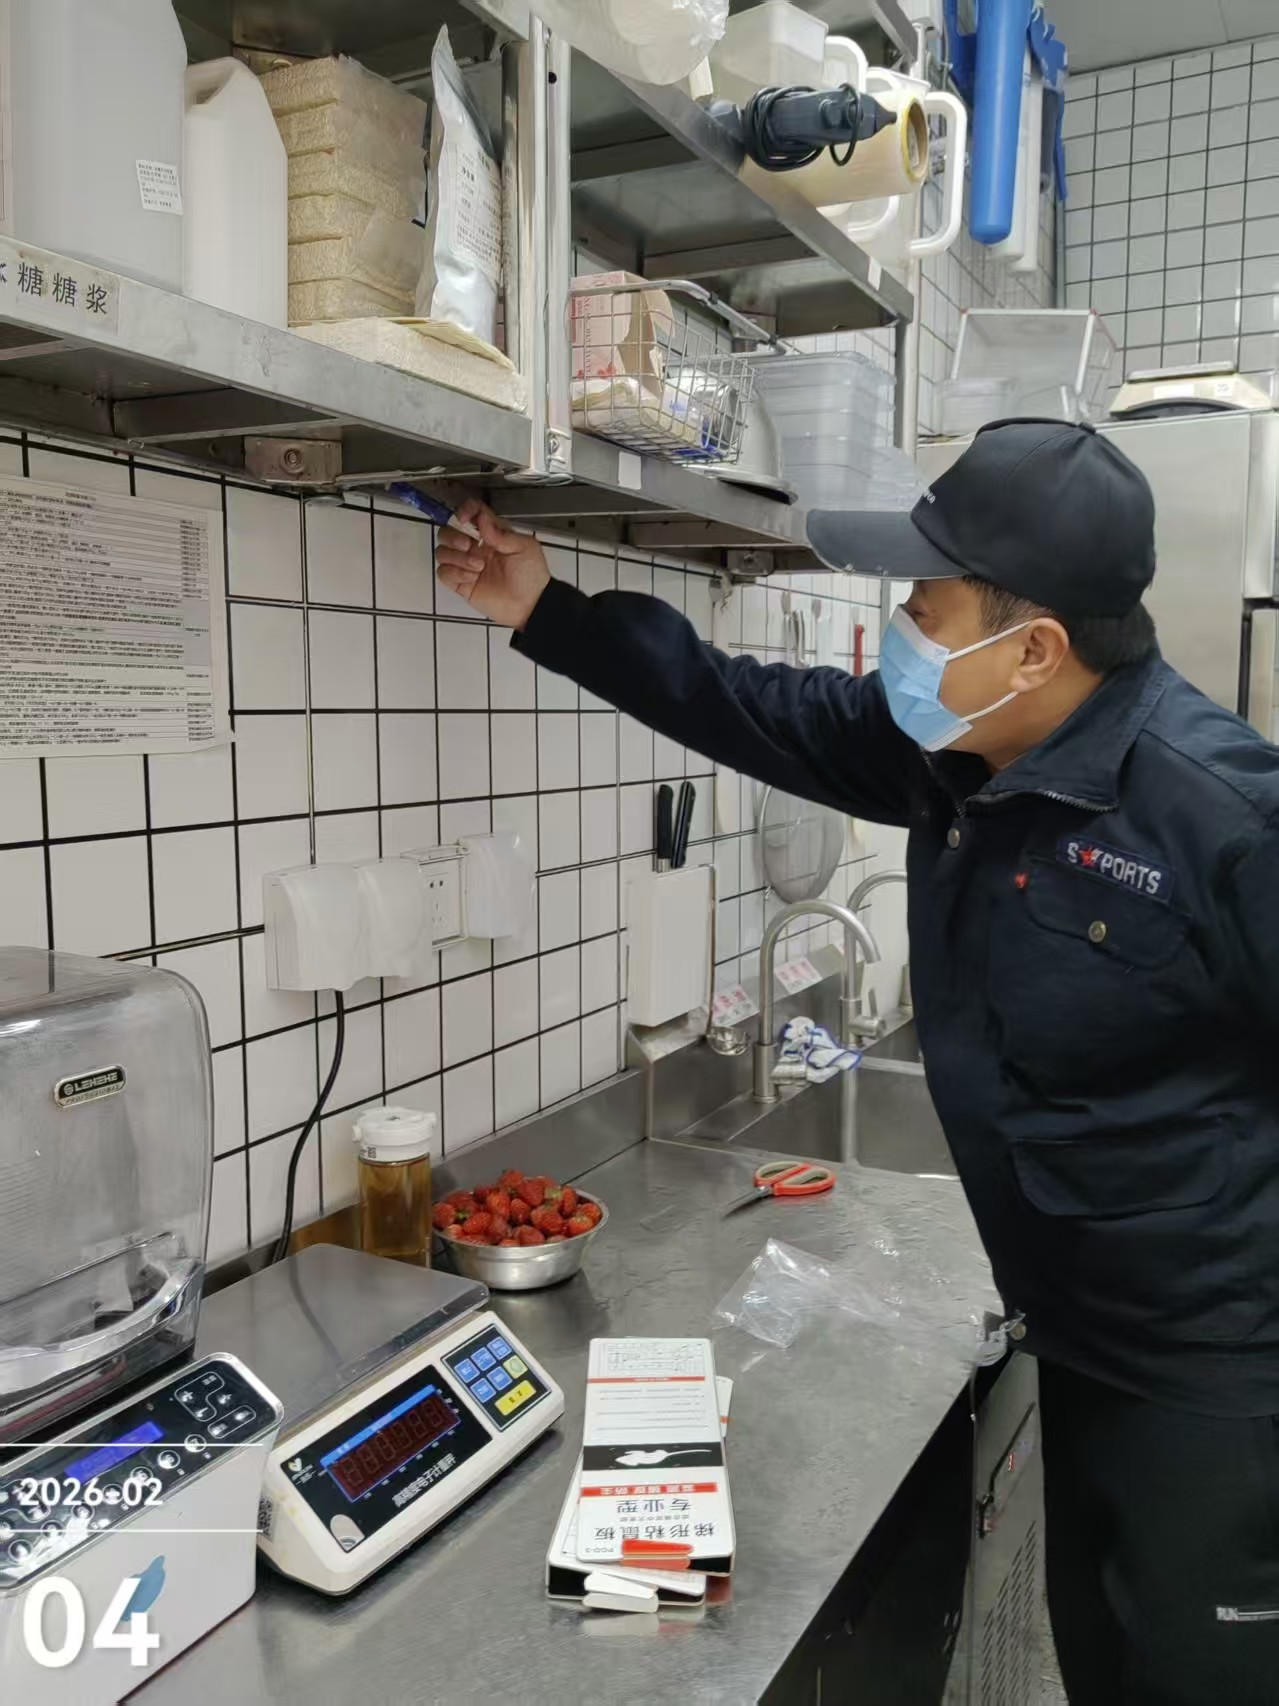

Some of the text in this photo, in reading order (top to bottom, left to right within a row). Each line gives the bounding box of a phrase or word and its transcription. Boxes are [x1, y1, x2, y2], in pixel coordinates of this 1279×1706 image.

[615, 1498, 692, 1513] 专业型
[594, 1522, 715, 1541] 梯形粘鼠板
